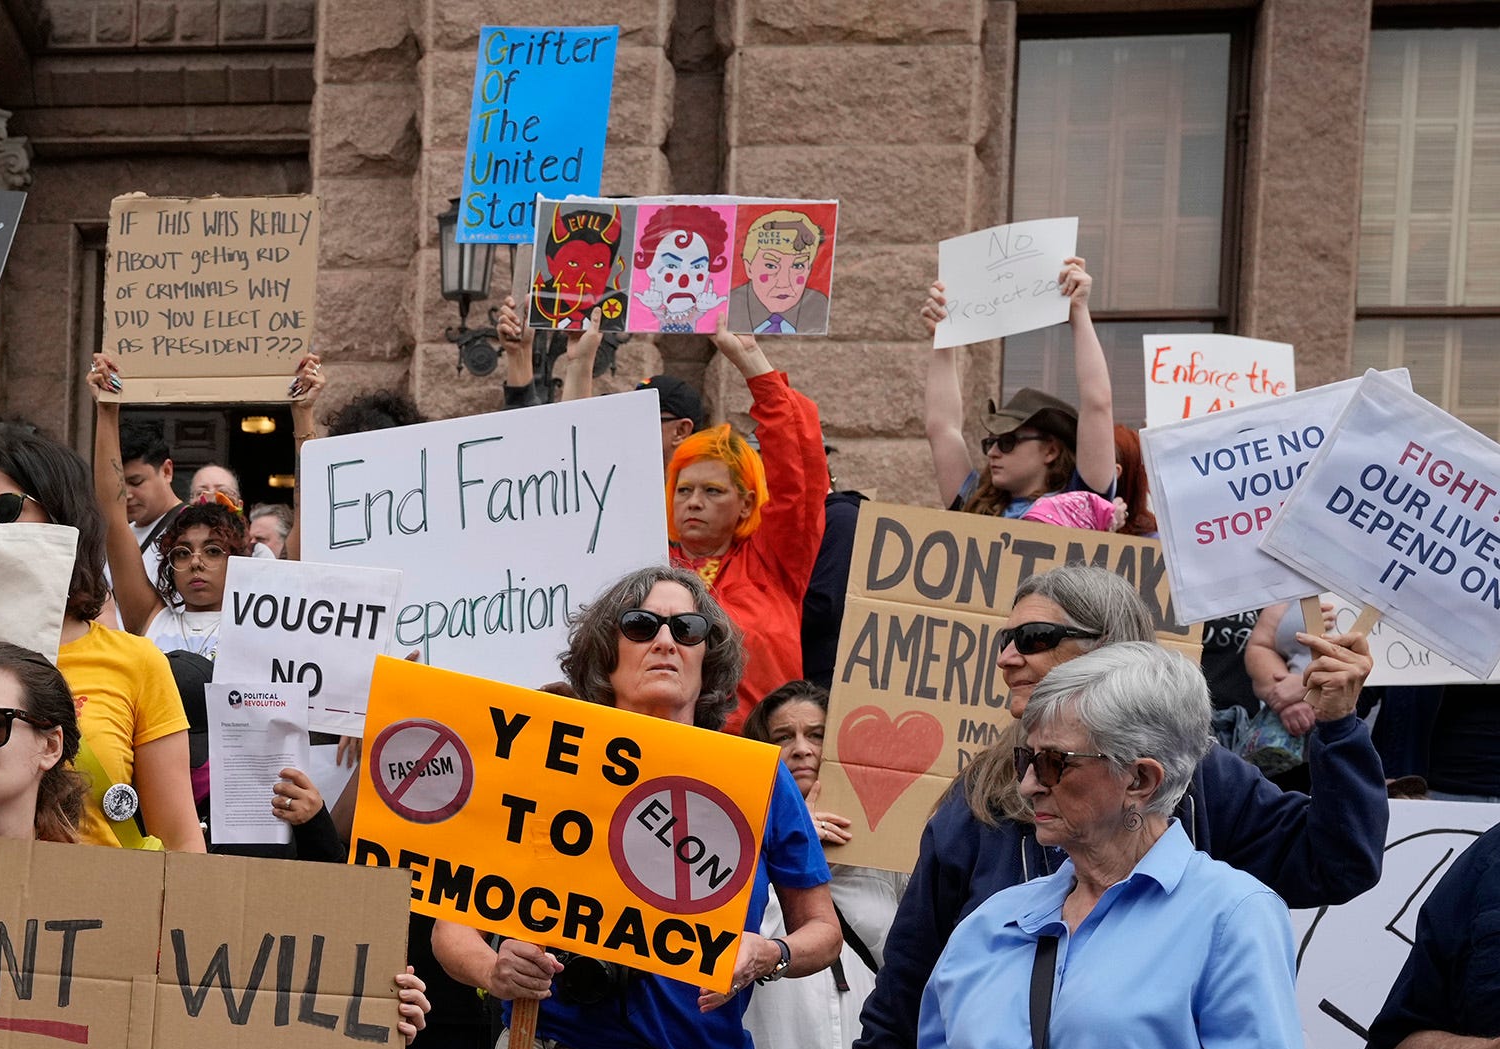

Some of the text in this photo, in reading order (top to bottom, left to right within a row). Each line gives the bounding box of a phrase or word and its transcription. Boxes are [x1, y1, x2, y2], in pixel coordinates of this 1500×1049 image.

[484, 30, 612, 65] Grifter
[481, 69, 520, 104] Of
[478, 108, 540, 143] The
[470, 147, 583, 184] United
[119, 209, 312, 245] IF THIS WAS REALLY
[568, 215, 600, 232] EVIL
[116, 246, 290, 274] ABOUT getting RID
[116, 278, 290, 302] OF CRIMINALS WHY
[115, 308, 306, 332] DID YOU ELECT ONE
[118, 335, 303, 360] AS PRESIDENT???
[1151, 346, 1286, 397] Enforce the
[1190, 425, 1325, 478] VOTE NO
[328, 425, 617, 554] End Family
[1360, 464, 1431, 520] OUR
[1194, 506, 1272, 544] STOP
[1326, 485, 1457, 576] DEPEND
[866, 517, 1056, 610] DON'T
[1379, 560, 1416, 592] IT
[233, 591, 386, 640] VOUGHT
[396, 569, 571, 666] eparation
[271, 658, 323, 698] NO
[488, 706, 642, 786] YES
[388, 756, 454, 780] FASCISM
[500, 794, 594, 857] TO
[636, 799, 732, 890] ELON
[355, 838, 738, 978] DEMOCRACY
[172, 929, 390, 1044] WILL
